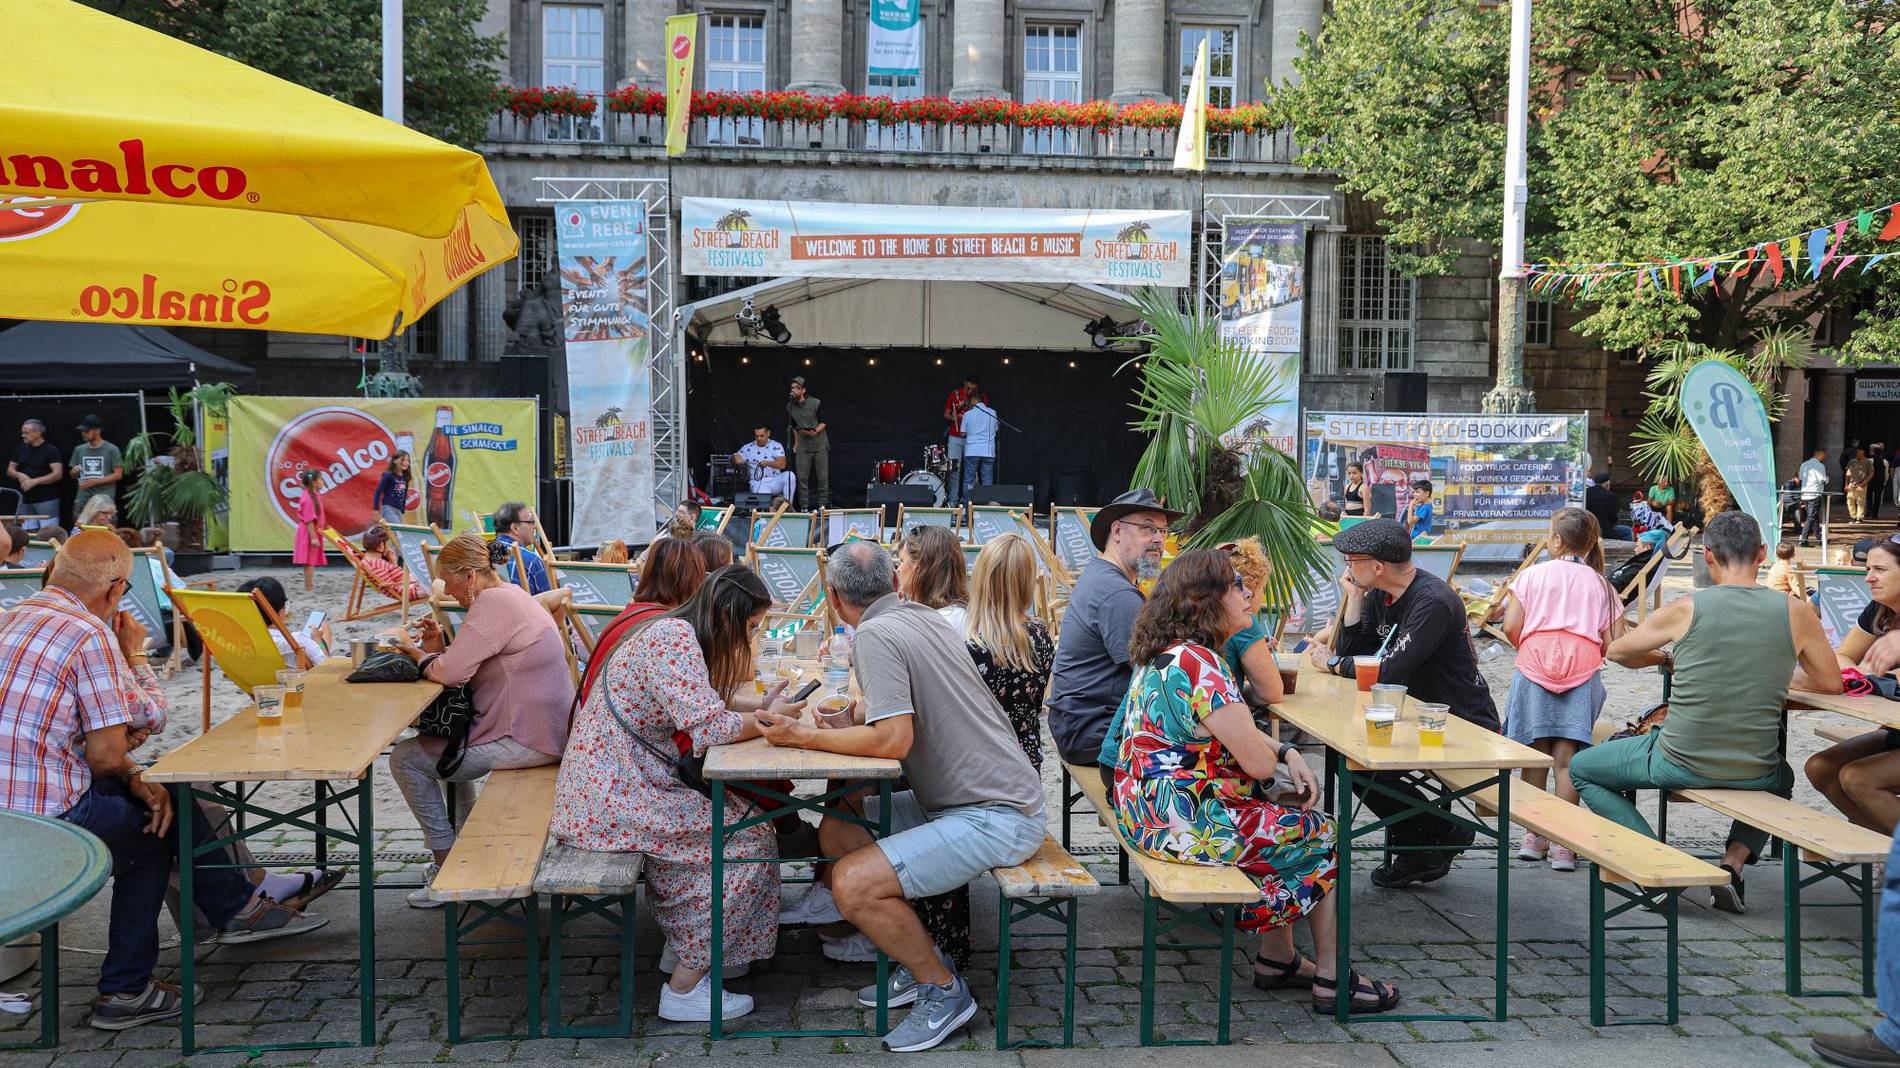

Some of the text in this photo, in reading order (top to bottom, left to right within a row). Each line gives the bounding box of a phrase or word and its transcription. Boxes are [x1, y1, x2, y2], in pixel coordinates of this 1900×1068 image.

[0, 138, 248, 201] nalco
[590, 204, 642, 219] EVENT
[692, 228, 779, 249] STREET BEACH
[806, 236, 1075, 257] WELCOME TO THE HOME OF STREET BEACH & MUSIC
[708, 250, 764, 268] FESTIVALS
[1094, 239, 1177, 262] STREET BEACH
[1108, 261, 1162, 279] FESTIVALS
[568, 289, 609, 300] EVENTS
[568, 302, 622, 313] FÜR GUTE
[570, 315, 633, 328] STIMMUNG!
[445, 423, 499, 435] DIE SINALCO
[614, 421, 646, 441] BEACH
[590, 440, 635, 459] FESTIVALS
[279, 438, 389, 510] Snalco
[1460, 463, 1553, 472] FOOD TRUCK CATERING
[1451, 474, 1560, 483] NACH DEINEM GESCHMACK
[1474, 496, 1491, 506] FÜR
